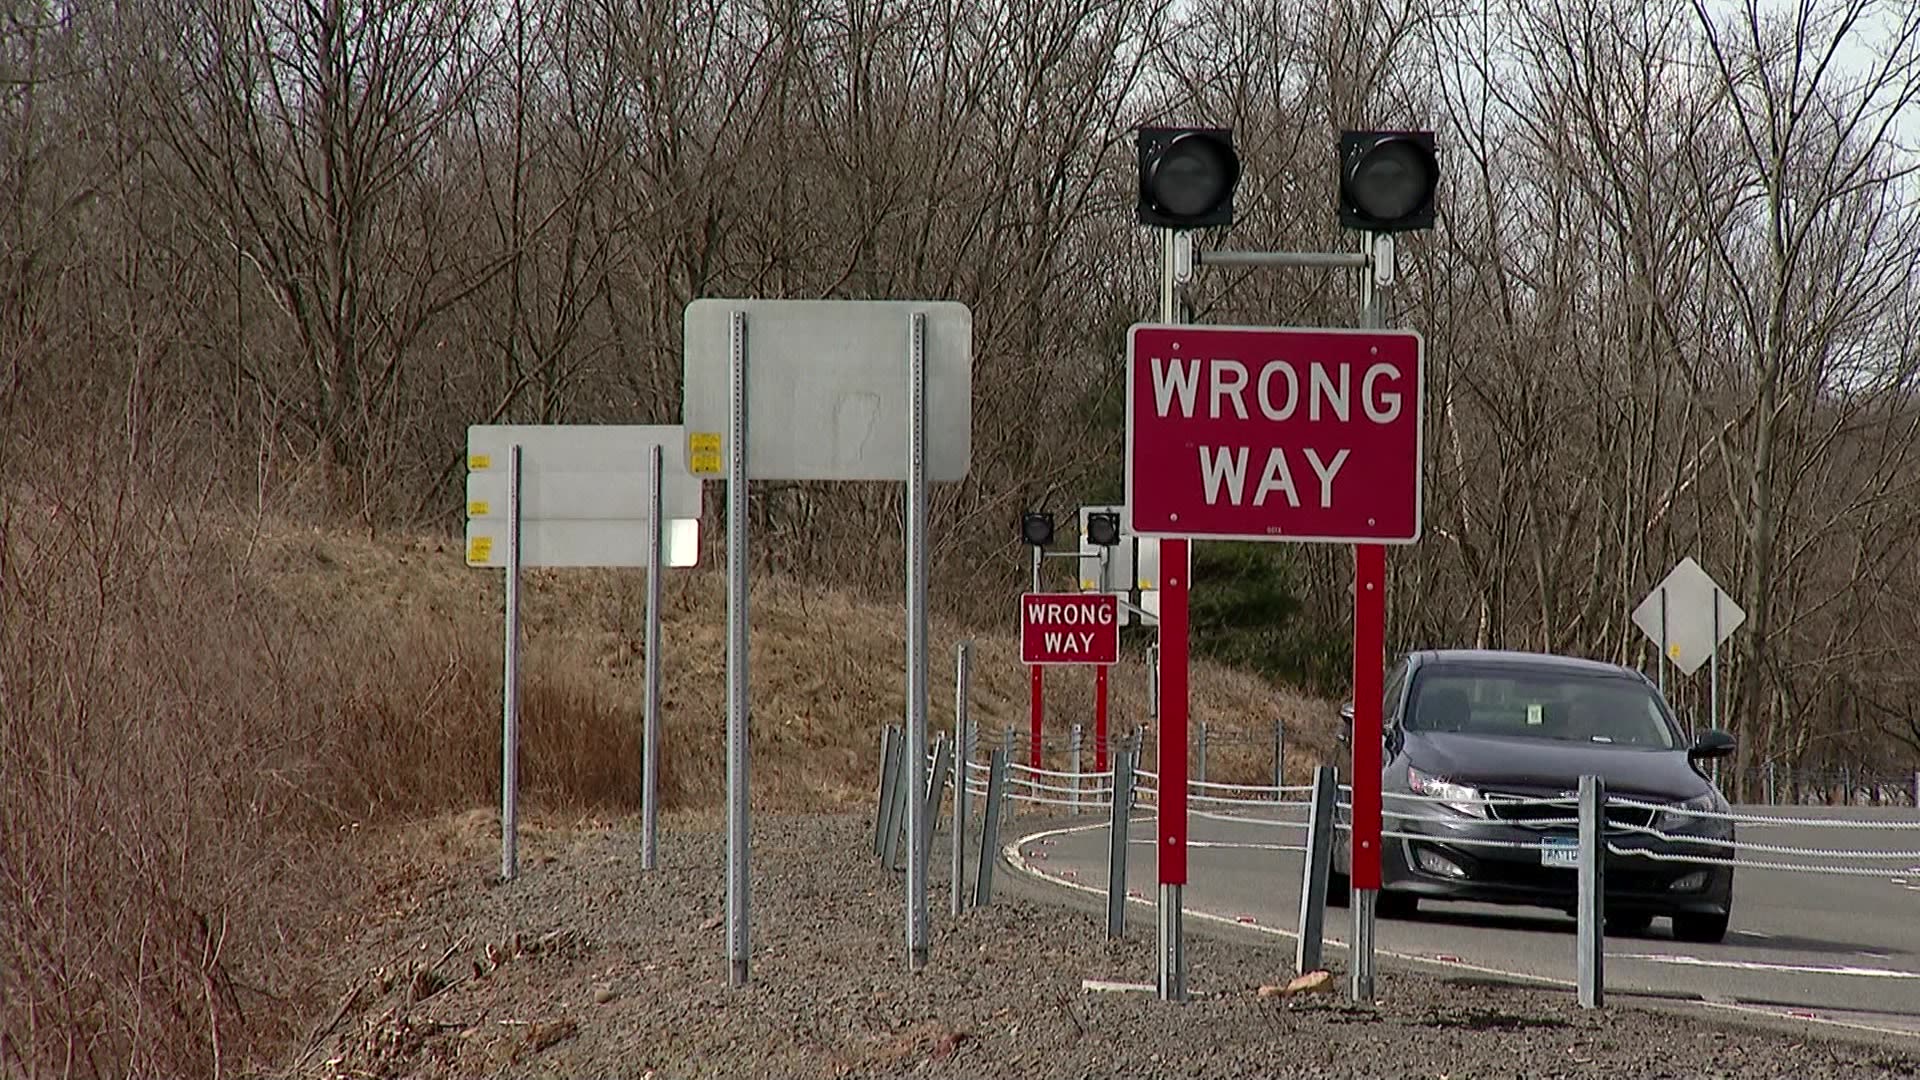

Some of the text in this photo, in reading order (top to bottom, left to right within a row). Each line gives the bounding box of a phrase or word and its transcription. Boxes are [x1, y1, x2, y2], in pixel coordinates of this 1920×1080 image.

[1150, 357, 1403, 424] WRONG
[1199, 445, 1351, 508] WAY
[1028, 603, 1112, 625] WRONG
[1044, 632, 1095, 653] WAY
